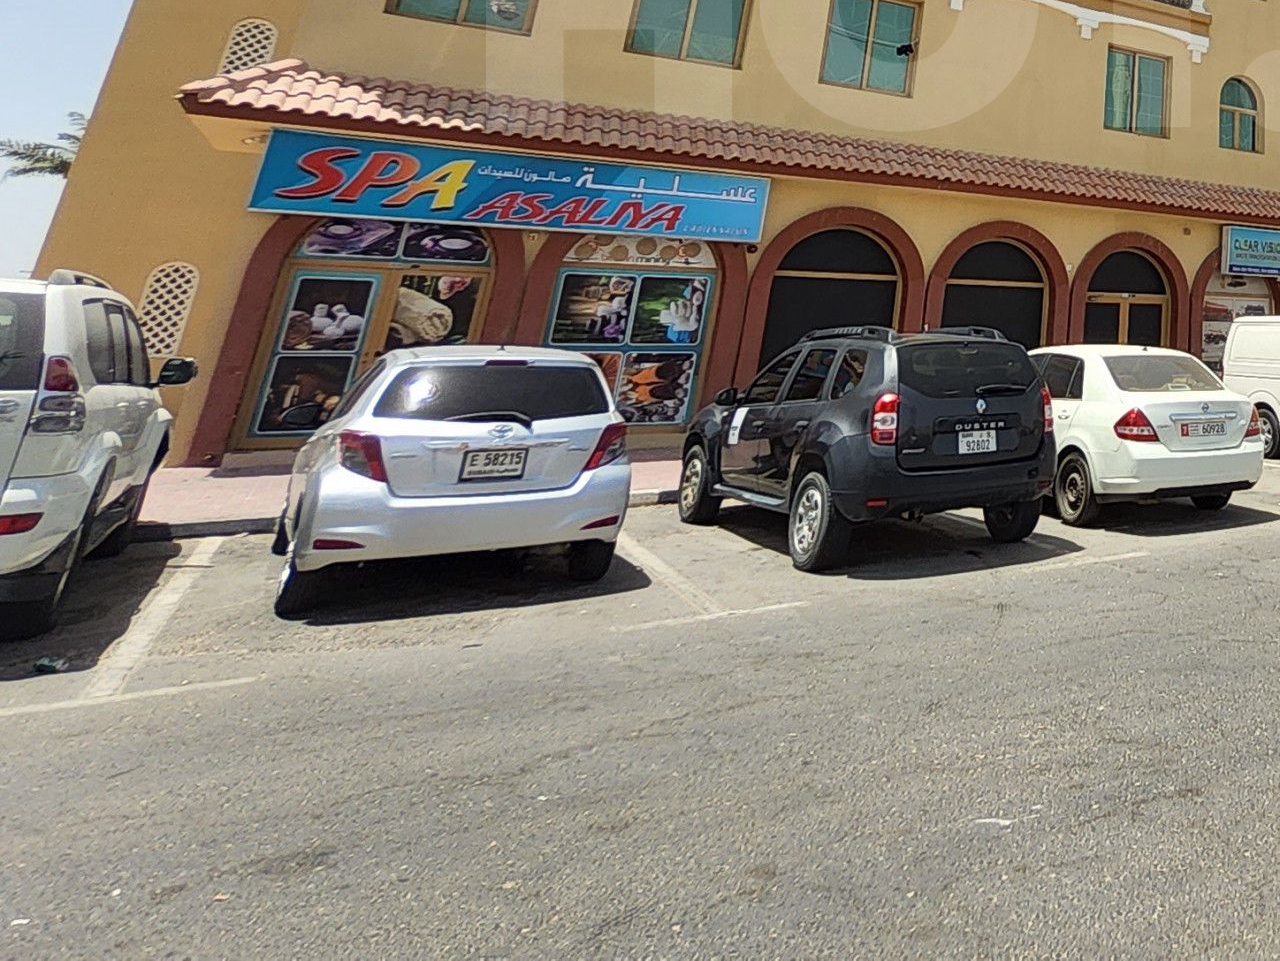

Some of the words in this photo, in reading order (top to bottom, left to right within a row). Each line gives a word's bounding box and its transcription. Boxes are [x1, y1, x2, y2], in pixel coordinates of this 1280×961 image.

[274, 146, 478, 211] SPA
[575, 166, 757, 203] عسلية
[465, 191, 687, 232] ASALIYA
[1233, 238, 1259, 252] CLEAR
[955, 421, 1005, 431] DUSTER
[1202, 422, 1225, 434] 60928
[469, 454, 479, 467] E
[483, 451, 523, 467] 58215
